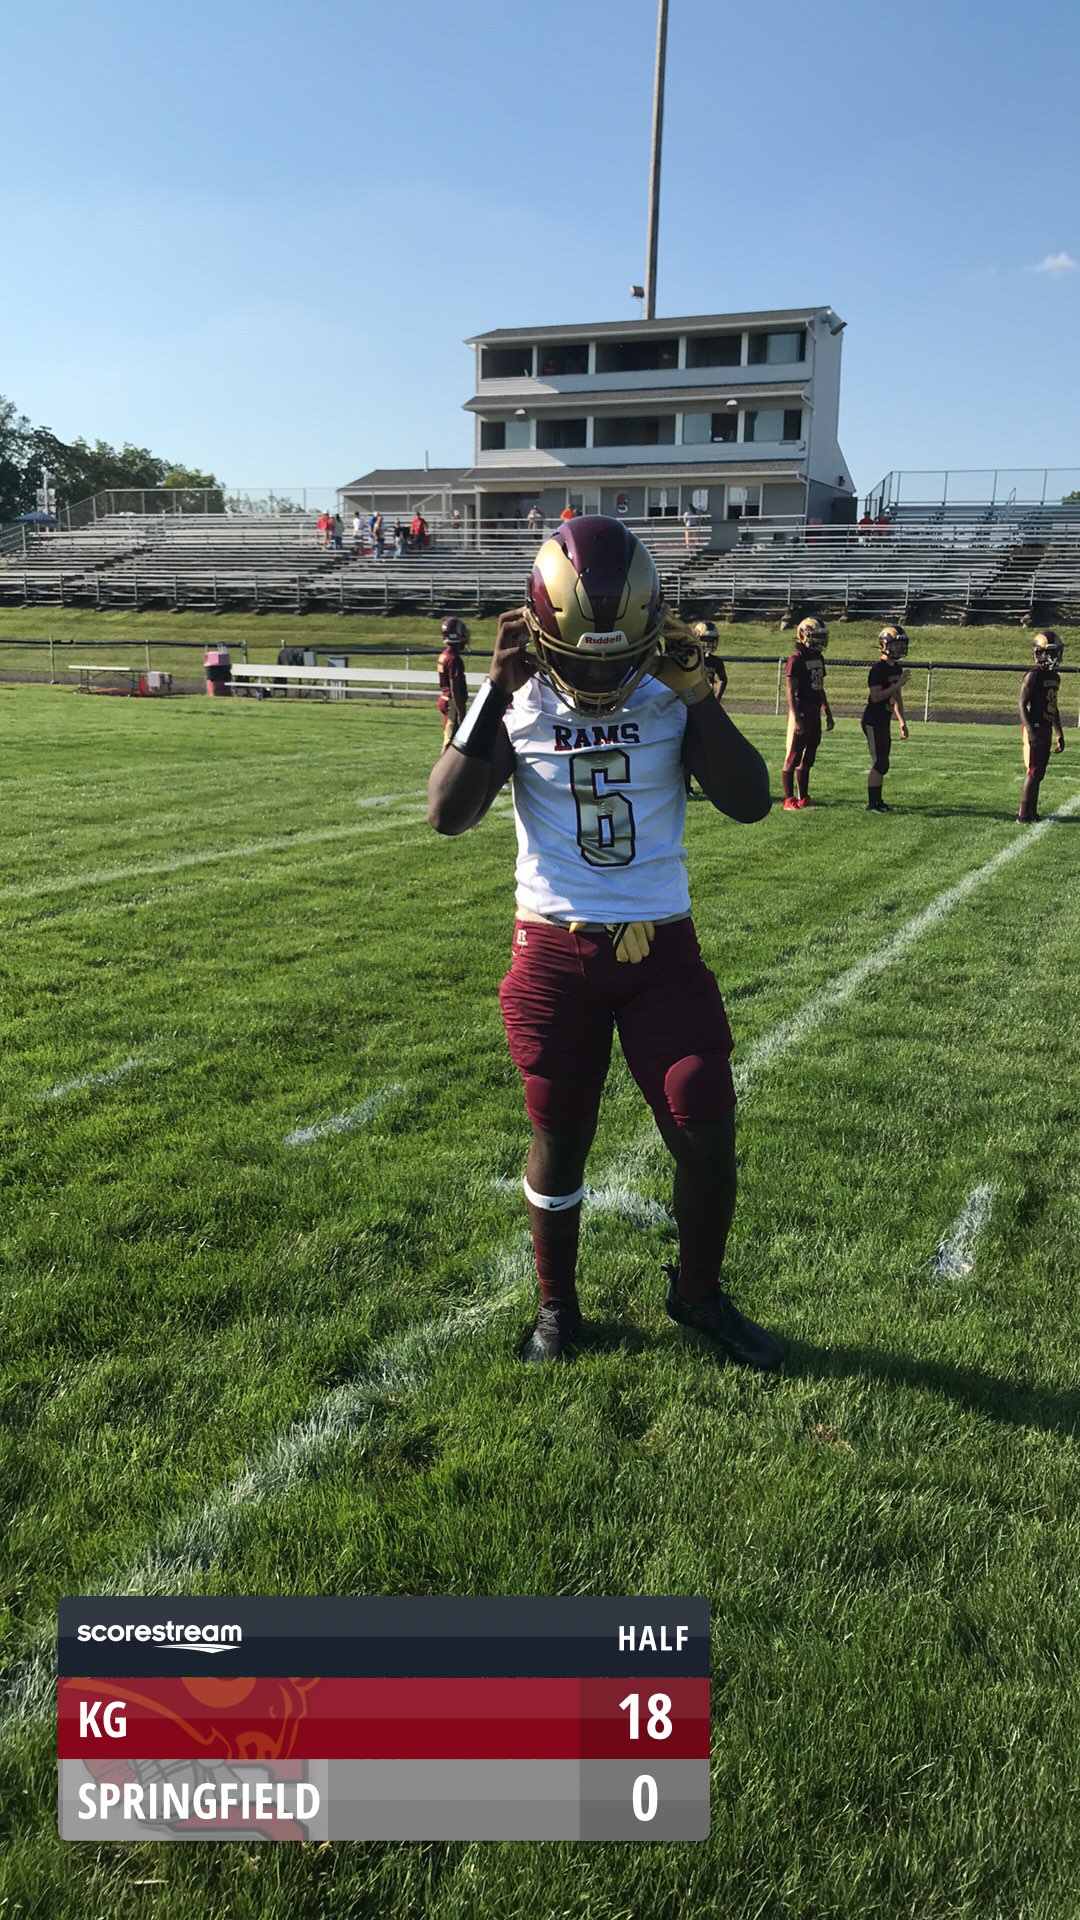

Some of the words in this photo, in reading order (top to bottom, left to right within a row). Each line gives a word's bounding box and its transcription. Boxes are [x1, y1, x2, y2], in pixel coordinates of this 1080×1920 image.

[585, 634, 622, 644] Riddell
[553, 723, 641, 751] RAMS
[569, 748, 636, 867] 6
